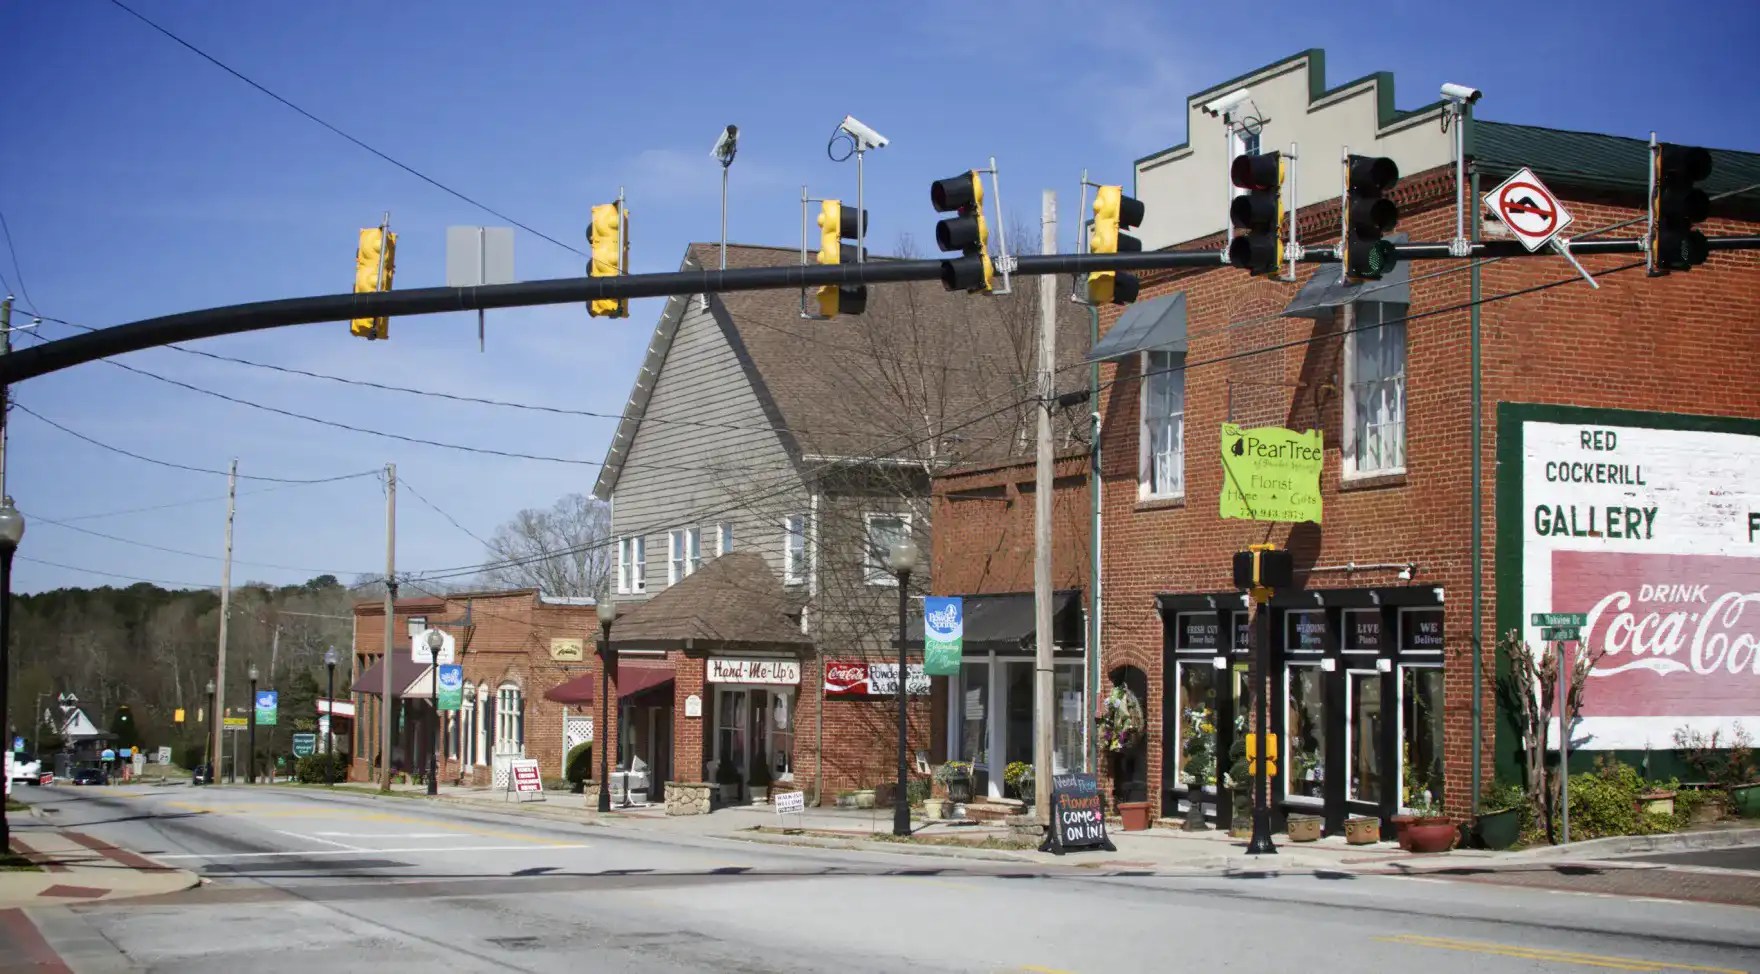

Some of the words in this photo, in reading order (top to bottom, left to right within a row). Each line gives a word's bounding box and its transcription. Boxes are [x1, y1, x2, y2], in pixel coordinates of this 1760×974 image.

[1580, 430, 1617, 451] RED
[1546, 461, 1647, 486] COCKERILL
[1251, 474, 1292, 490] Florist
[1534, 504, 1660, 540] GALLERY
[1638, 583, 1710, 603] DRINK
[1357, 623, 1380, 634] LIVE
[1420, 622, 1438, 633] WE
[1359, 635, 1378, 644] Plants
[1414, 635, 1443, 645] Deliver
[828, 667, 865, 681] Coca-Cola
[870, 665, 900, 680] Powde
[872, 682, 880, 691] 5
[1053, 775, 1077, 789] Need
[777, 798, 802, 807] WELCOME
[1067, 826, 1083, 840] ON
